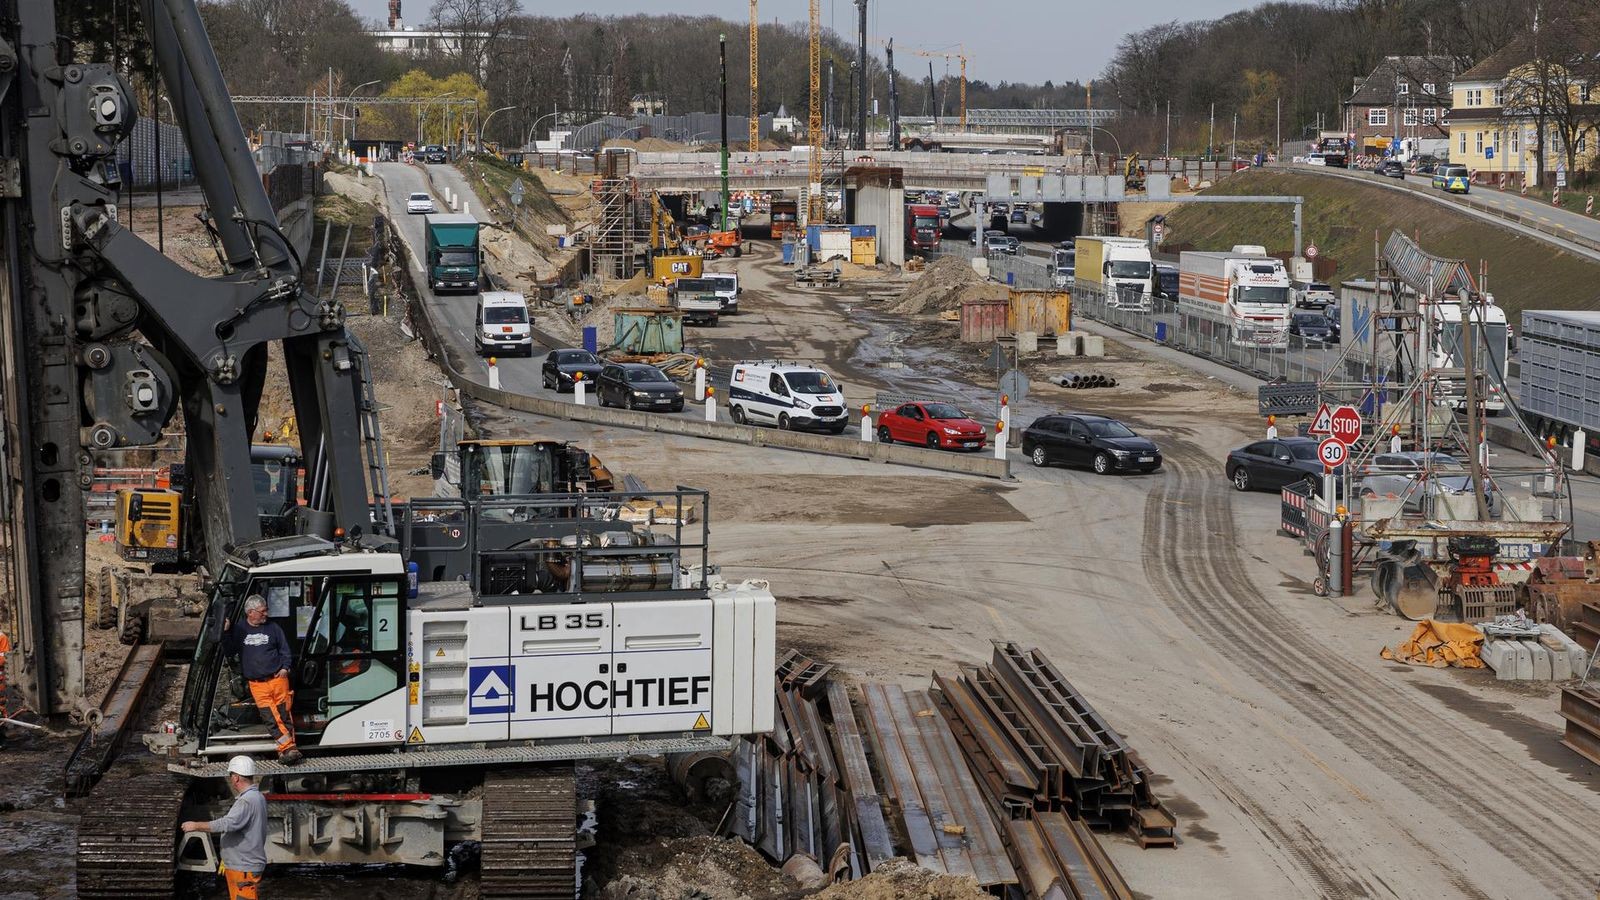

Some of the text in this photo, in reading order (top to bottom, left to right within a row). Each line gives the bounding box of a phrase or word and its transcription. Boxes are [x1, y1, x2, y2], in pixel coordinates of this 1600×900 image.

[671, 262, 688, 273] CAT
[1333, 417, 1359, 434] STOP
[1324, 446, 1341, 460] 30
[379, 618, 388, 633] 2
[521, 616, 557, 631] LB
[530, 675, 711, 713] HOCHTIEF
[369, 731, 390, 739] 2705
